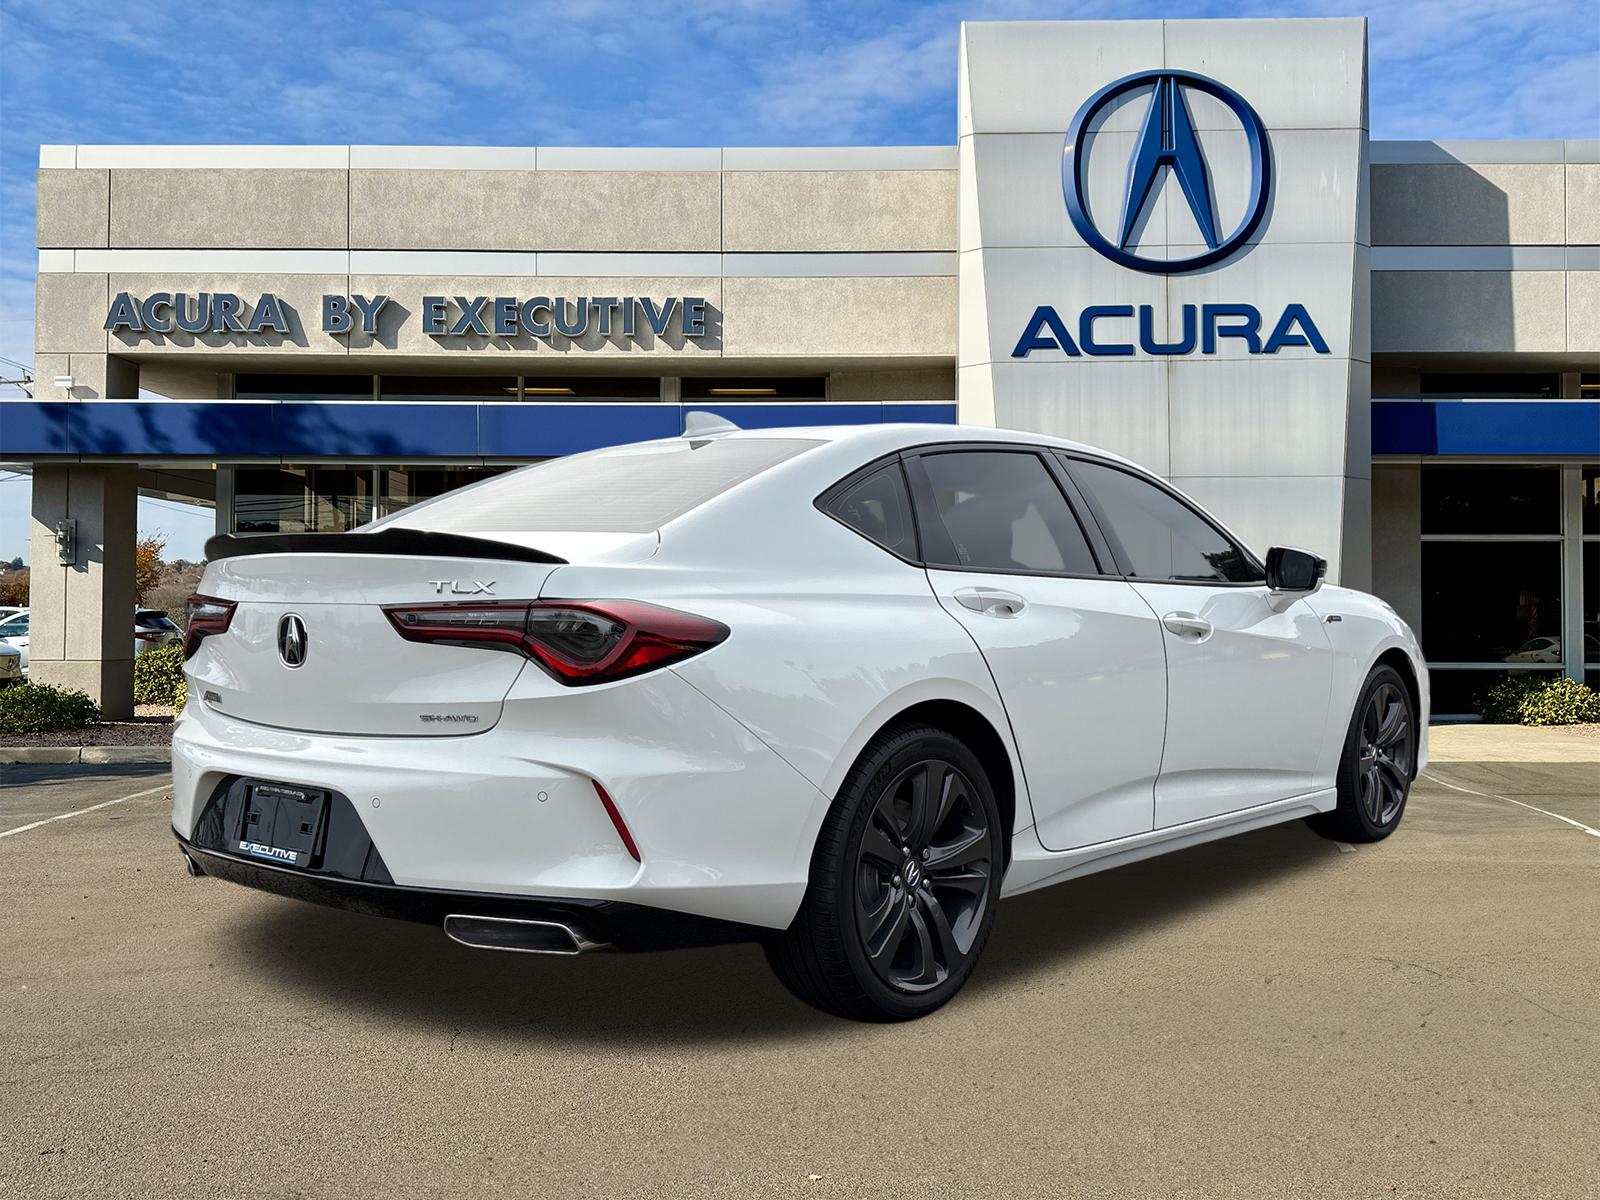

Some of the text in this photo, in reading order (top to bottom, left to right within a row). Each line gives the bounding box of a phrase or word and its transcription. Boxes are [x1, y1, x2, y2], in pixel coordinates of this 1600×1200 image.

[103, 292, 707, 336] ACURA BY EXECUTIVE
[1010, 303, 1332, 357] ACURA
[428, 580, 497, 595] TLX
[239, 840, 298, 861] EXECUTIVE
